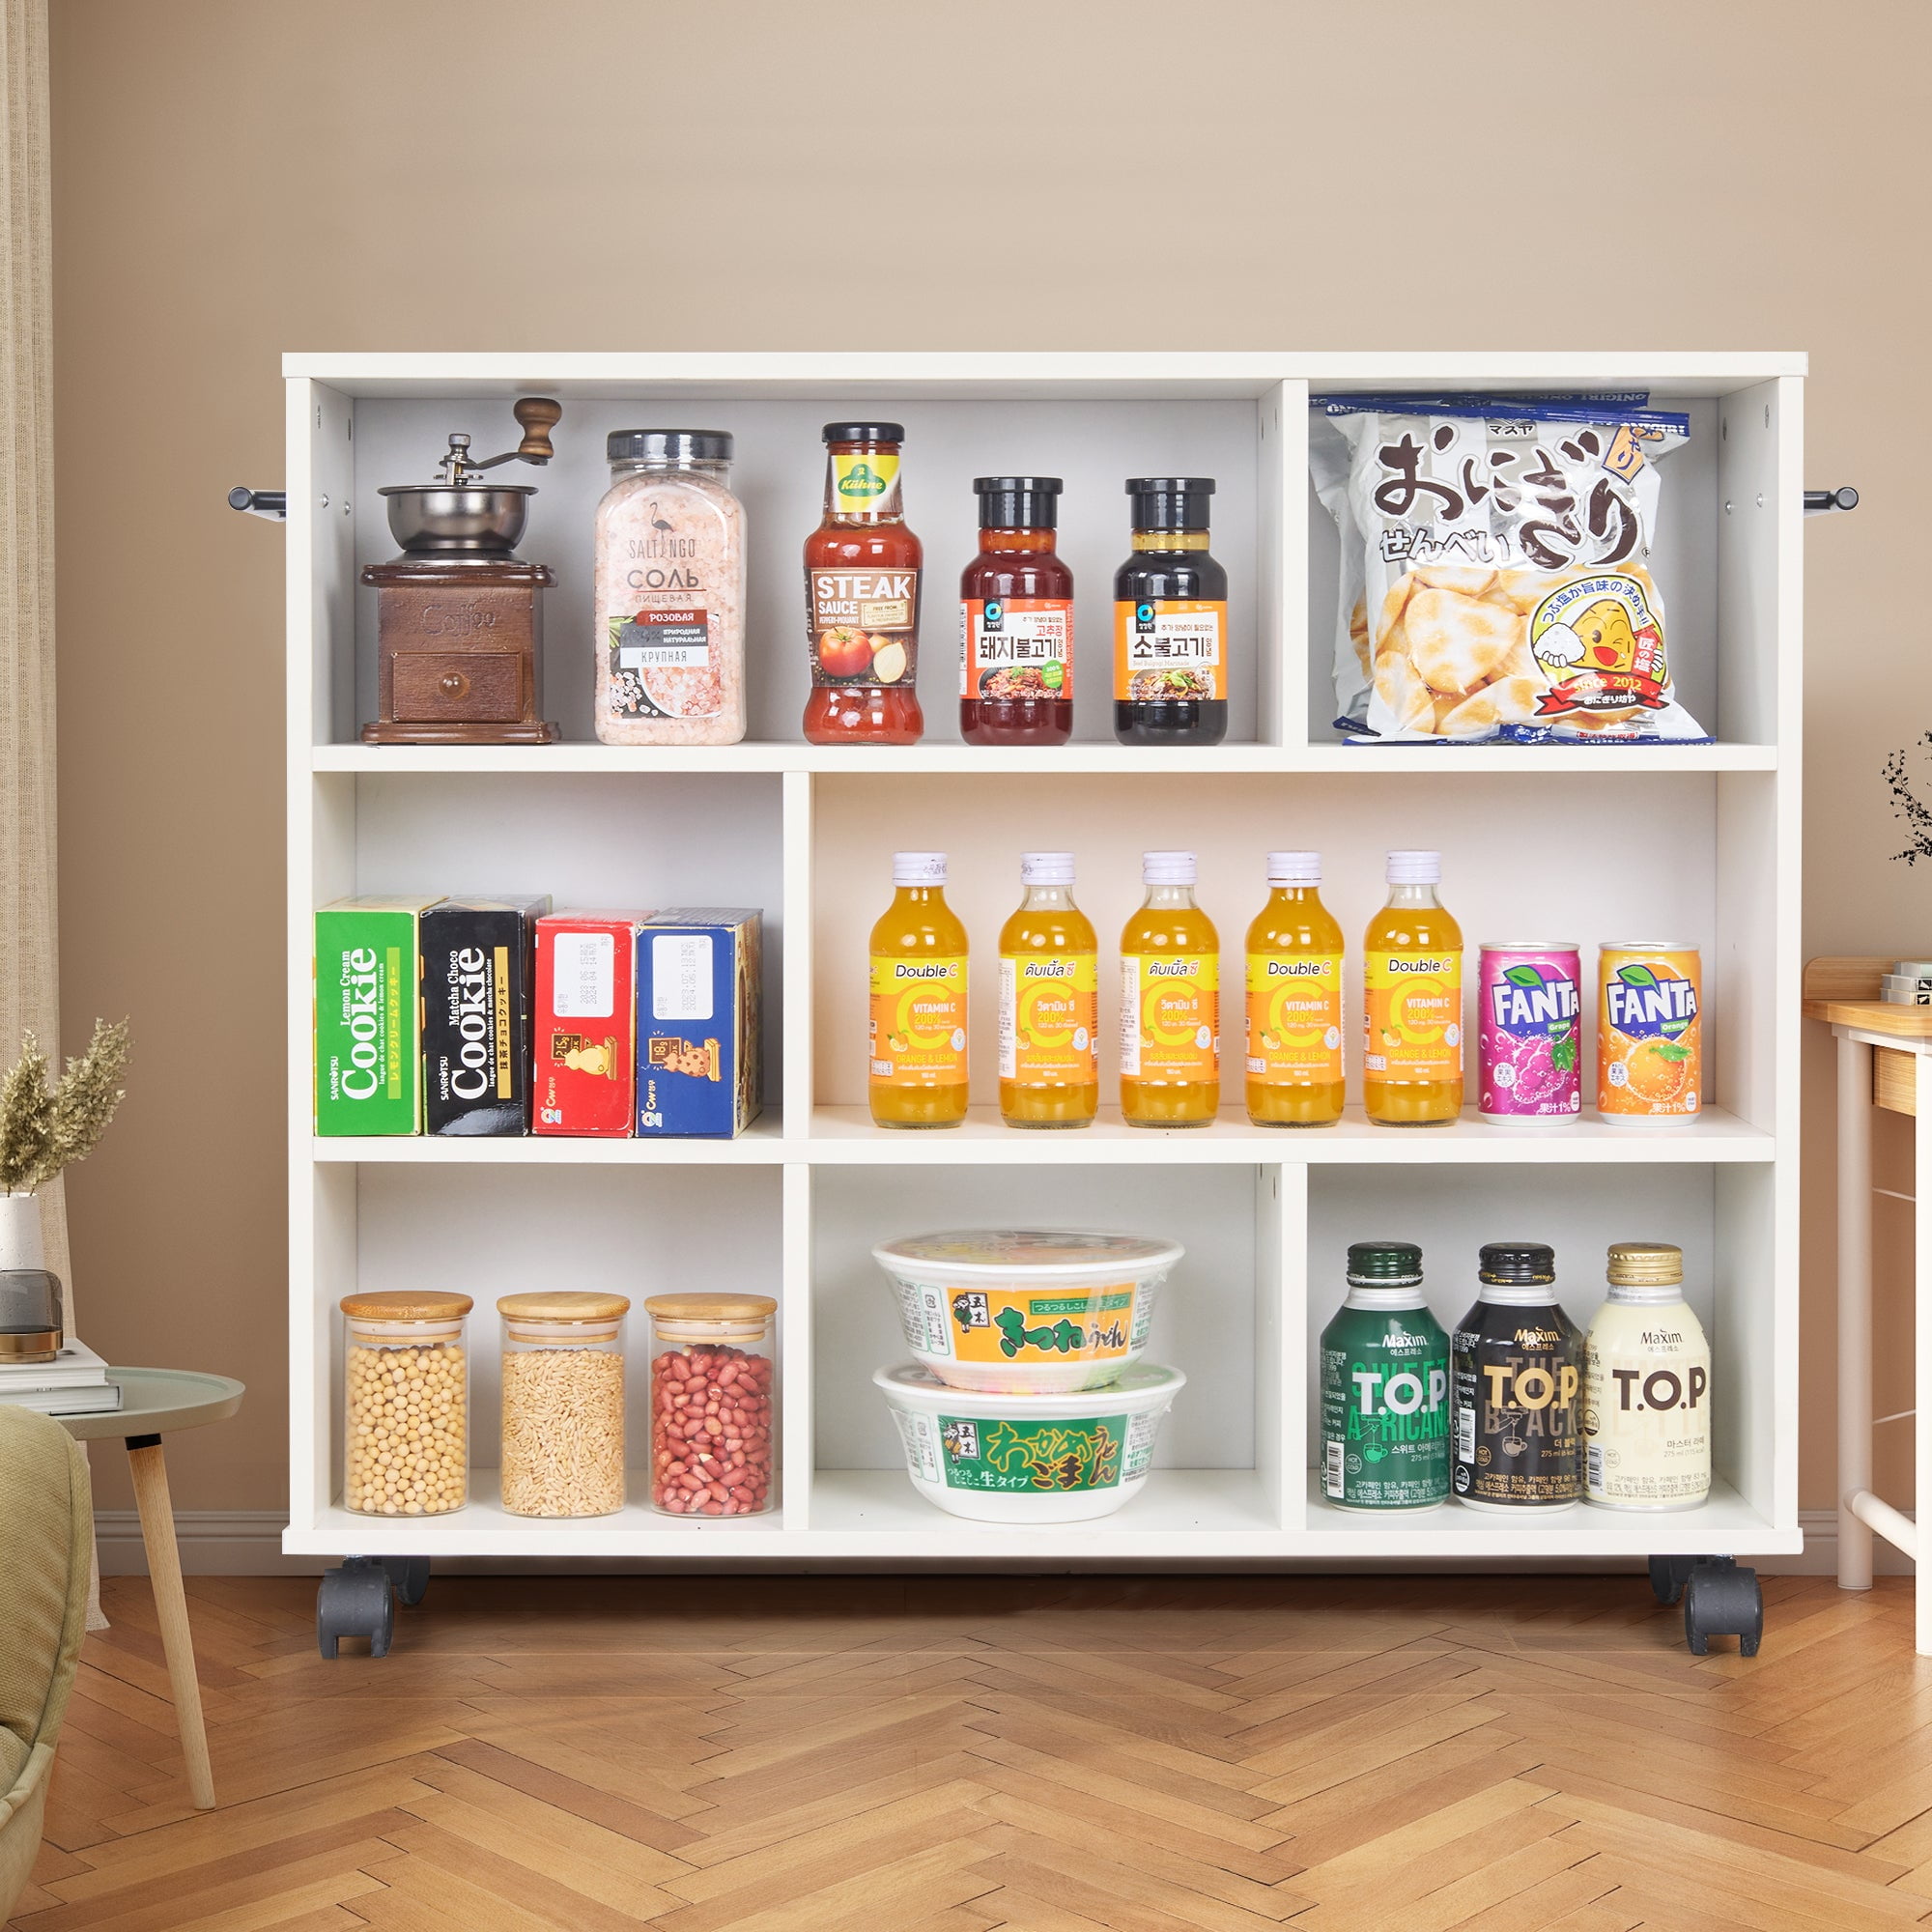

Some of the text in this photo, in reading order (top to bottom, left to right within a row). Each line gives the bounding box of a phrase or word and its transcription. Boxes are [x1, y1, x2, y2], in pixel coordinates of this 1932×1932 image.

[1489, 424, 1533, 437] マスヤ
[840, 479, 883, 491] Kühne
[1374, 425, 1640, 572] おにぎり
[1380, 529, 1511, 563] せんべい
[627, 568, 699, 588] СОЛЬ
[817, 576, 911, 600] STEAK
[635, 594, 693, 604] ПИЩЕВАЯ
[818, 601, 858, 615] SAUCE
[648, 612, 695, 623] РОЗОВАЯ
[1036, 625, 1063, 637] 고추장
[980, 636, 1057, 660] 돼지불고기
[1133, 635, 1205, 659] 소불고기
[641, 650, 687, 663] КРУПНАЯ
[1634, 637, 1656, 673] 匠の塩
[1575, 677, 1642, 693] since 2012
[1583, 694, 1636, 705] おにぎり坊や
[895, 964, 957, 978] Double C
[1025, 960, 1074, 977] ดับเบิ้ล ซี
[1150, 959, 1199, 976] ดับเบิ้ล ซี
[1268, 961, 1330, 975] Double C
[1389, 959, 1451, 972] Double C
[340, 951, 351, 1026] Lemon Cream
[447, 951, 460, 1026] Matcha Choco
[913, 1003, 955, 1013] VITAMIN C
[1037, 1000, 1075, 1011] วิตามิน ซี
[1160, 999, 1199, 1010] วิตามิน ซี
[1286, 1000, 1329, 1011] VITAMIN C
[1406, 998, 1450, 1009] VITAMIN C
[1492, 980, 1580, 1026] FANTA
[1607, 980, 1697, 1025] FANTA
[915, 1013, 941, 1024] 200%
[1037, 1012, 1065, 1022] 200%
[1161, 1010, 1188, 1021] 200%
[1287, 1011, 1314, 1022] 200%
[1406, 1009, 1435, 1019] 200%
[341, 948, 378, 1099] Cookie
[389, 966, 399, 1081] レモンクリームクッキー
[451, 948, 488, 1100] Cookie
[497, 977, 509, 1069] 抹茶チョコクッキー
[1548, 1022, 1571, 1032] Grape
[1662, 1021, 1689, 1031] Orange
[654, 1040, 668, 1056] 18g
[1390, 1049, 1451, 1059] ORANGE & LEMON
[378, 1054, 385, 1063] de
[488, 1057, 495, 1065] de
[896, 1053, 958, 1064] ORANGE & LEMON
[1268, 1051, 1330, 1061] ORANGE & LEMON
[378, 1064, 386, 1085] langue
[1539, 1102, 1572, 1114] 果汁1%
[1653, 1102, 1687, 1114] 果汁1%
[1382, 1331, 1428, 1349] Maxim
[1515, 1326, 1561, 1343] Maxim
[1641, 1329, 1683, 1346] Maxim
[1390, 1349, 1423, 1357] 에스프레소
[1521, 1343, 1554, 1351] 에스프레소
[1352, 1370, 1446, 1415] T.O.P
[1483, 1366, 1578, 1410] T.O.P
[1612, 1366, 1707, 1411] T.O.P
[1485, 1400, 1578, 1436] BACK
[986, 1421, 1093, 1473] わかめ
[1391, 1444, 1416, 1455] 스위트
[1553, 1438, 1562, 1448] 더
[1666, 1438, 1691, 1449] 마스터
[1088, 1425, 1119, 1487] うどん
[1411, 1454, 1423, 1463] 275
[1031, 1454, 1084, 1491] ごま
[1485, 1472, 1509, 1483] 고카페인
[980, 1470, 1029, 1489] 生タイプ
[1355, 1480, 1381, 1490] 고카페인
